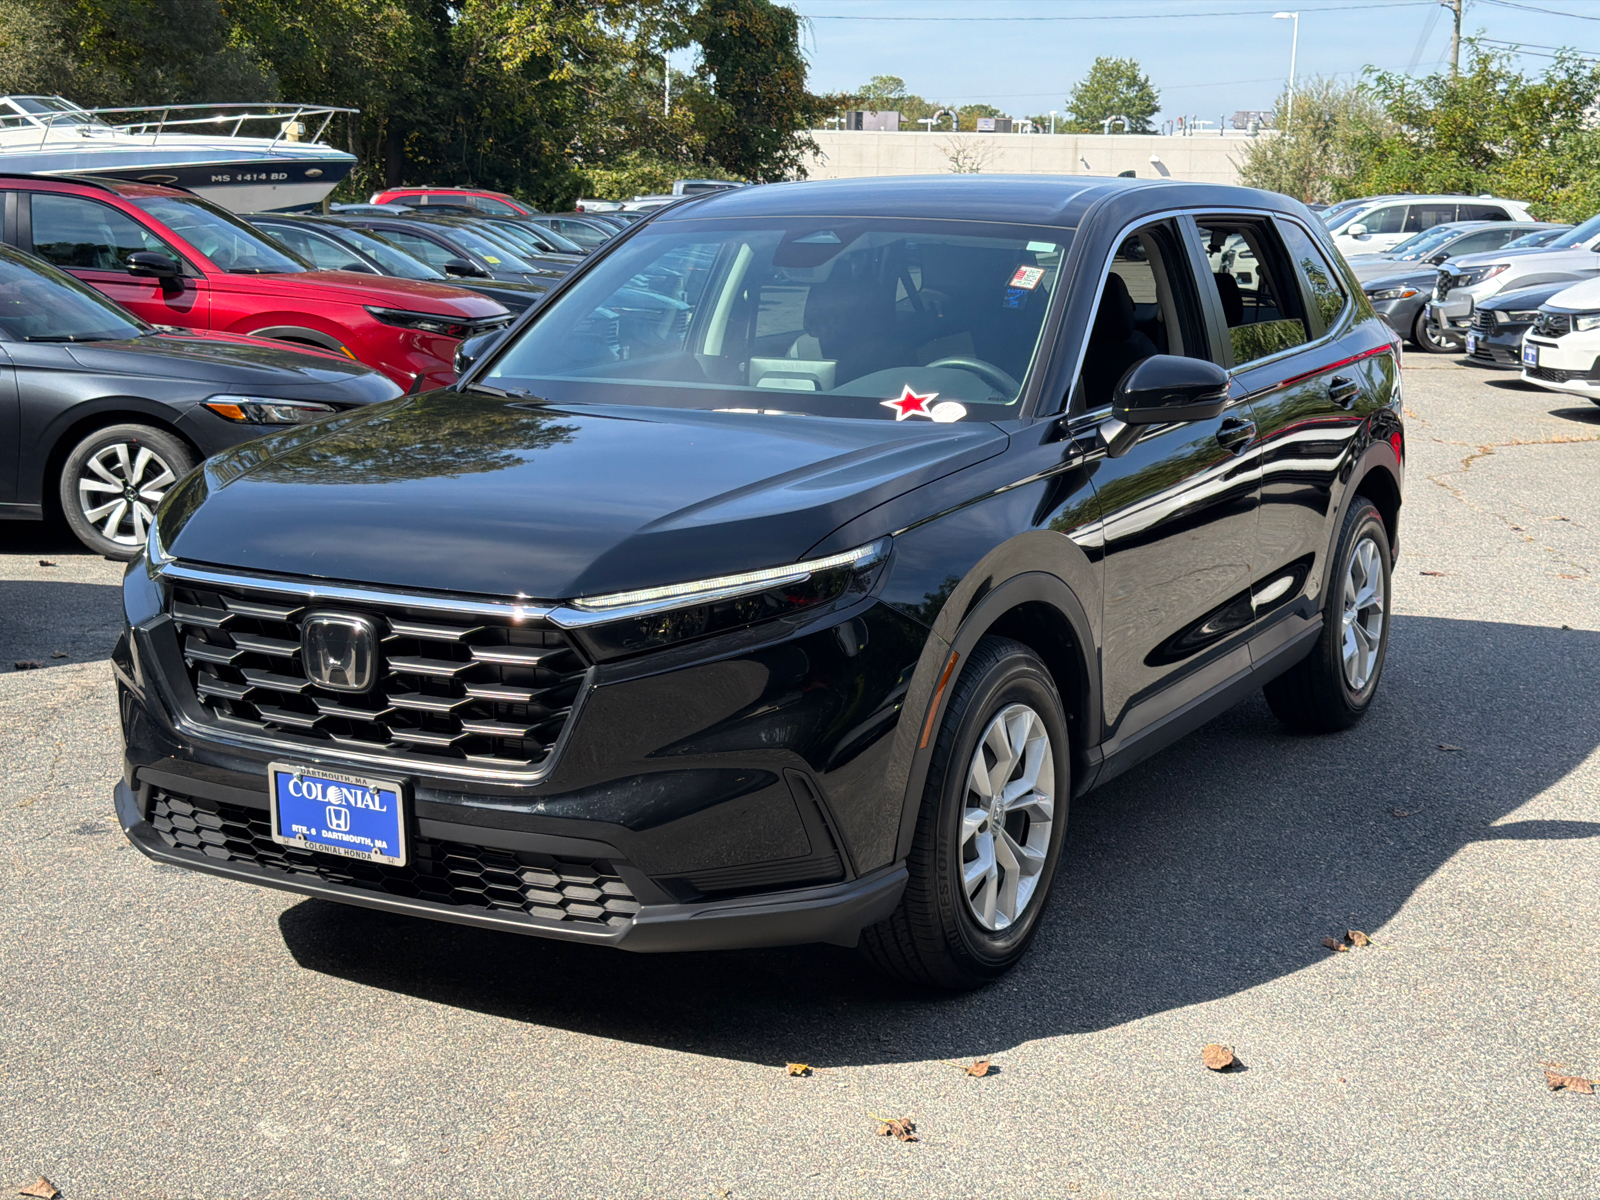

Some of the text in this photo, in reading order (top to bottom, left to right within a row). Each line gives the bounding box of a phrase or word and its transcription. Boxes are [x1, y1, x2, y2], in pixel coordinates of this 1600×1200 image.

[211, 174, 231, 182] MS
[270, 172, 288, 180] BD
[288, 779, 386, 812] COLONIAL
[292, 824, 387, 848] RTE. 6 DARTMOUTH, MA
[304, 841, 373, 861] COLONIAL HONDA
